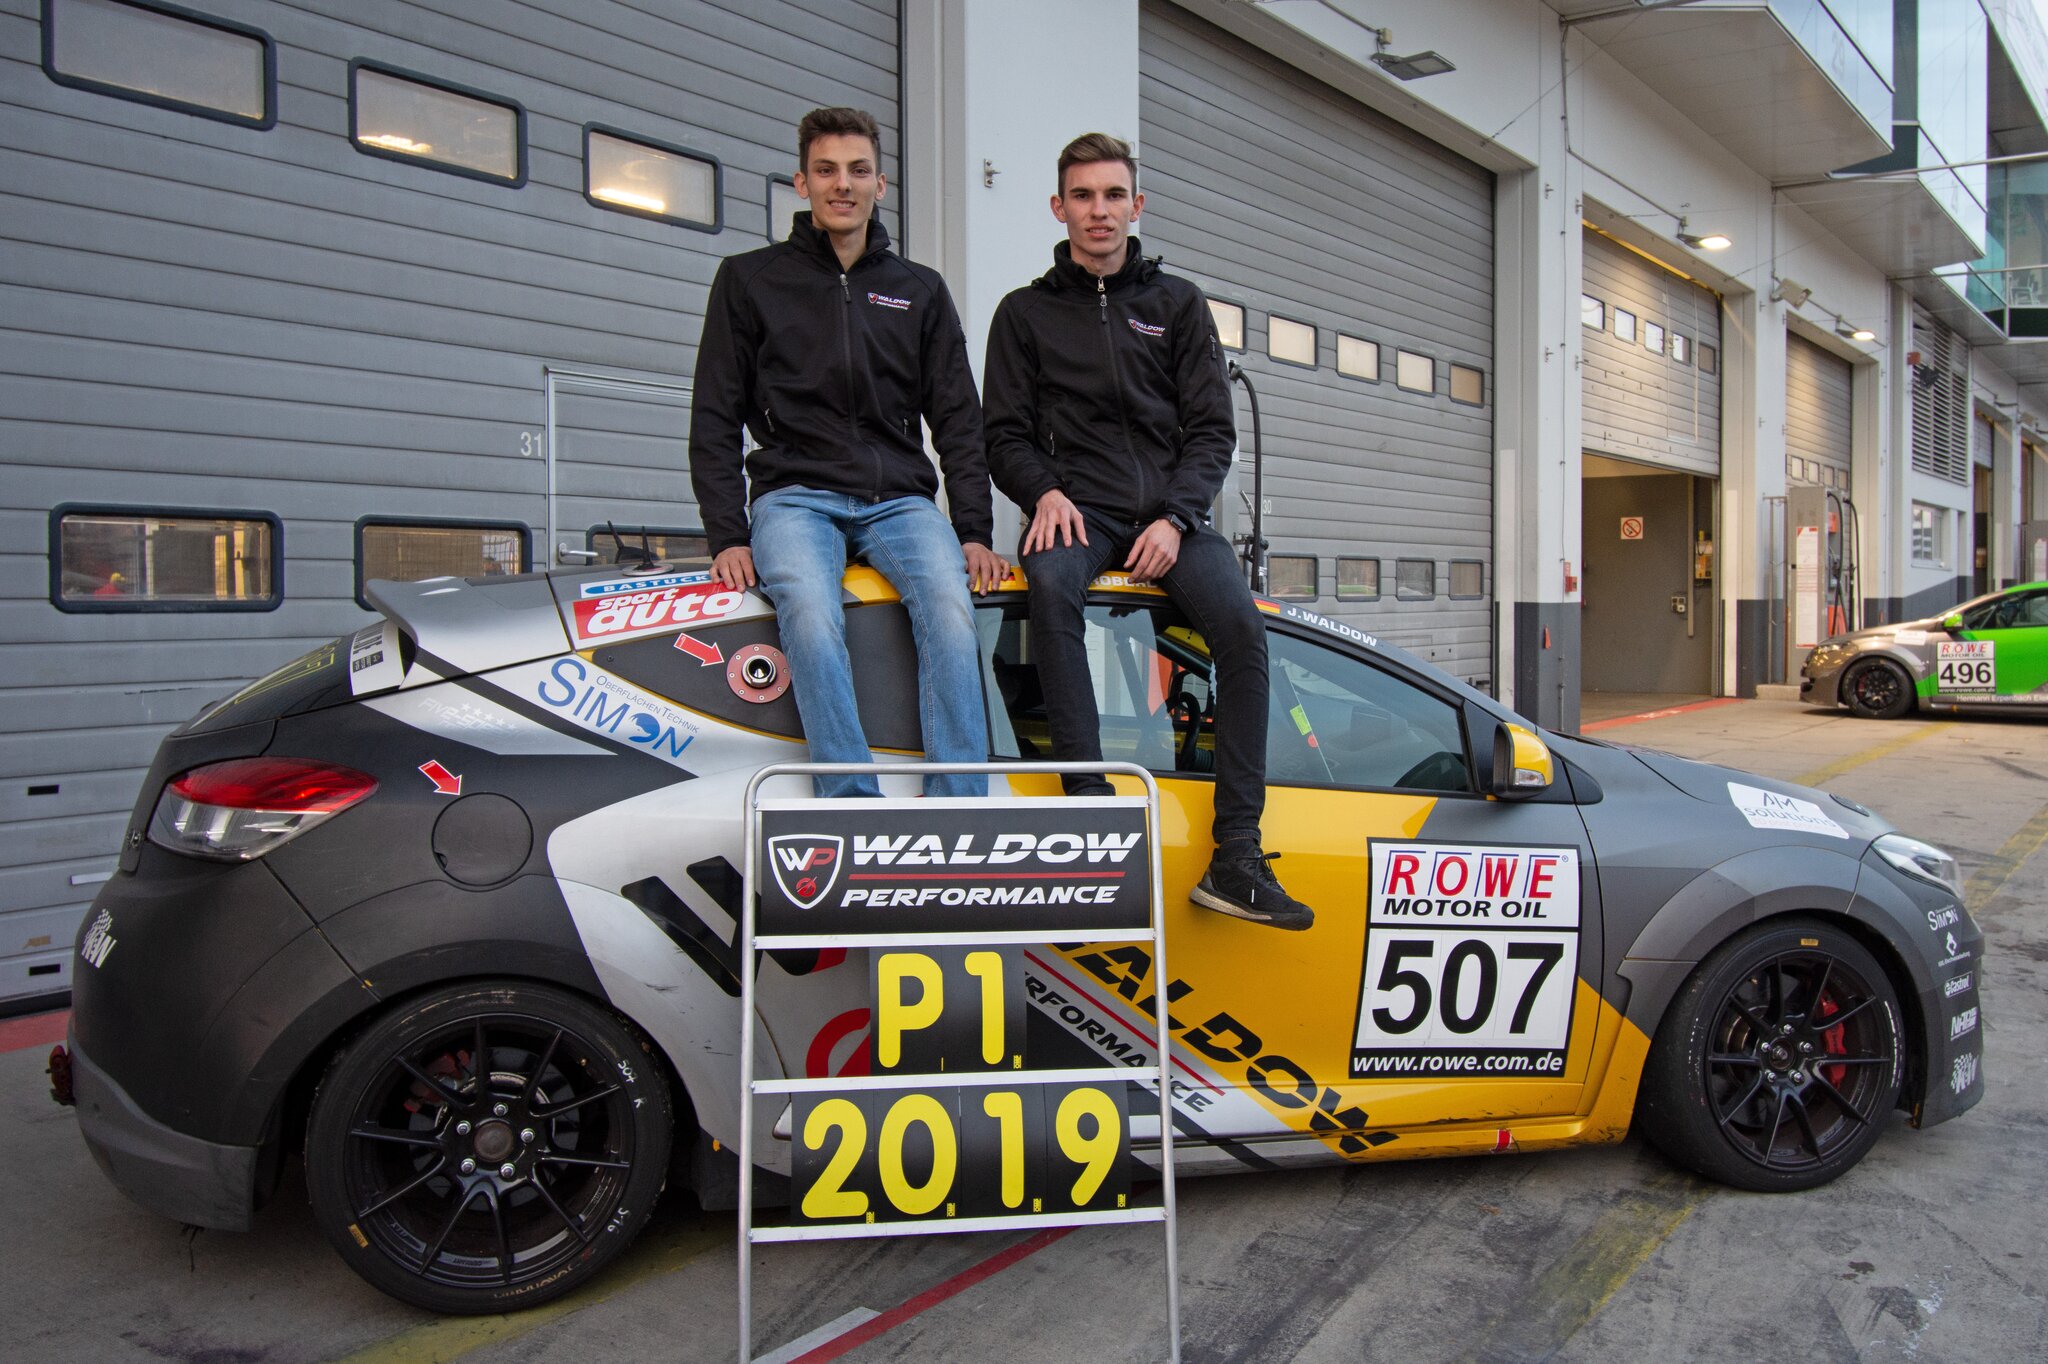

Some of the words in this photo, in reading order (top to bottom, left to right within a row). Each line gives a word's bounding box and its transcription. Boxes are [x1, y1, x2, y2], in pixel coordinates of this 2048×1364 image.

[520, 432, 542, 457] 31
[603, 575, 711, 593] BASTUCK
[595, 588, 680, 611] sport
[587, 591, 744, 634] auto
[1287, 607, 1378, 647] J.WALDOW
[1942, 643, 1988, 653] ROWE
[1940, 662, 1992, 684] 496
[662, 706, 700, 735] TECHNIK
[777, 847, 836, 872] WP
[853, 832, 1142, 865] WALDOW
[1384, 852, 1557, 899] ROWE
[839, 886, 1120, 907] PERFORMANCE
[1383, 898, 1491, 917] MOTOR
[1501, 901, 1548, 918] OIL
[1372, 939, 1565, 1035] 507
[1353, 1052, 1563, 1072] www.rowe.com.de
[801, 1087, 1121, 1218] 2019
